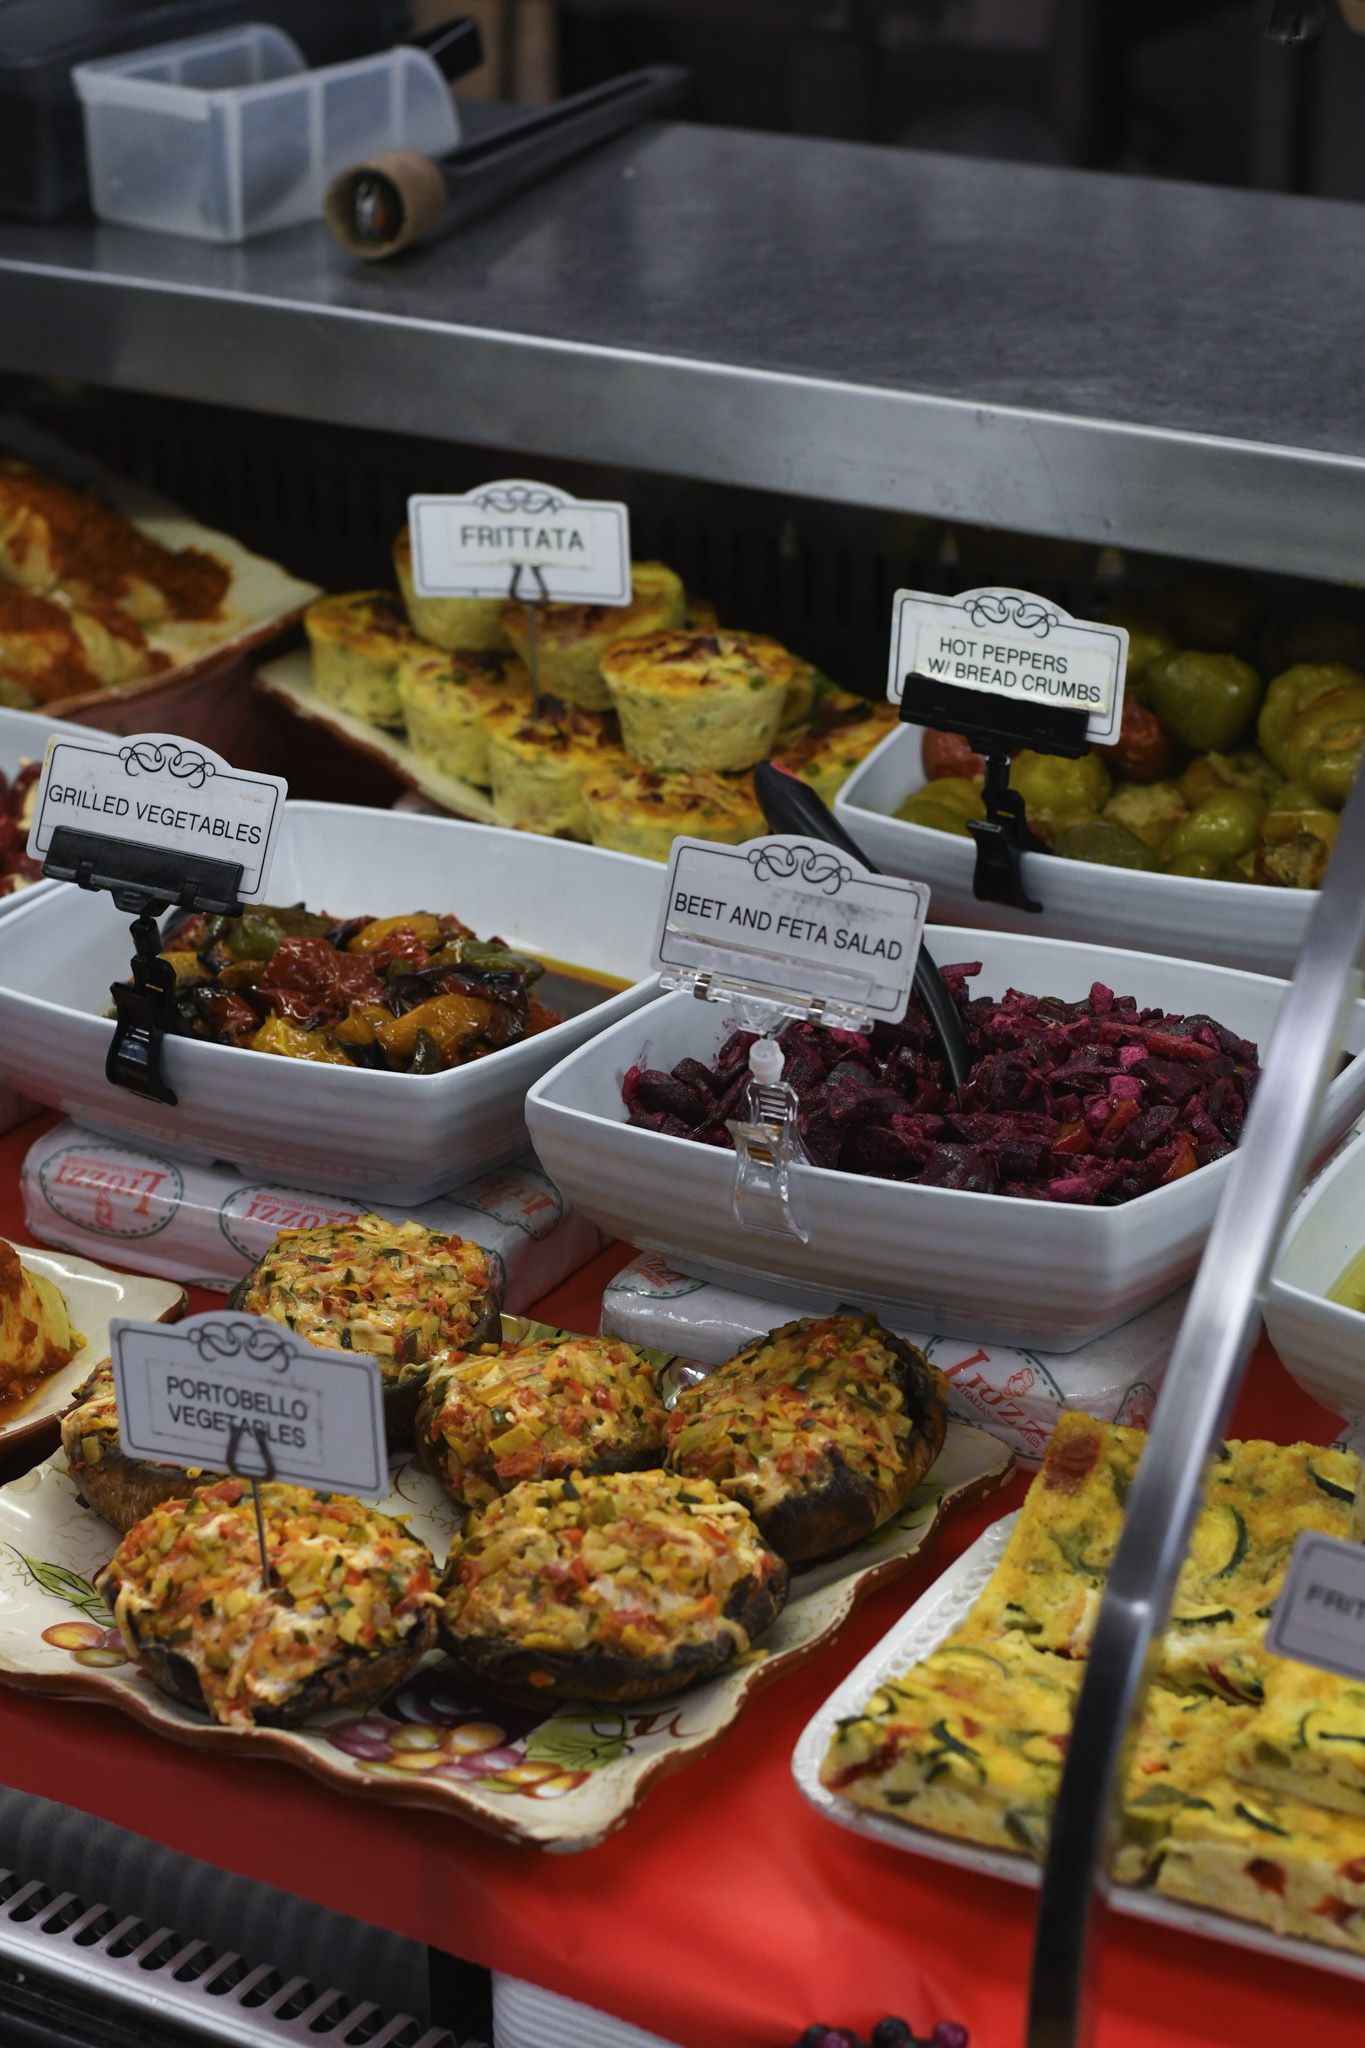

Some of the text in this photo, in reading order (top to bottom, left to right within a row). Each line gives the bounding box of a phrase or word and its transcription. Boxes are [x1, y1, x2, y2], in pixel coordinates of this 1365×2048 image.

[460, 525, 585, 550] FRITTATA
[940, 637, 1068, 674] HOT PEPPERS
[928, 657, 1101, 703] W/ BREAD CRUMBS
[48, 784, 262, 845] GRILLED VEGETABLES
[674, 892, 903, 961] BEET AND FETA SALAD
[167, 1375, 308, 1421] PORTOBELLO
